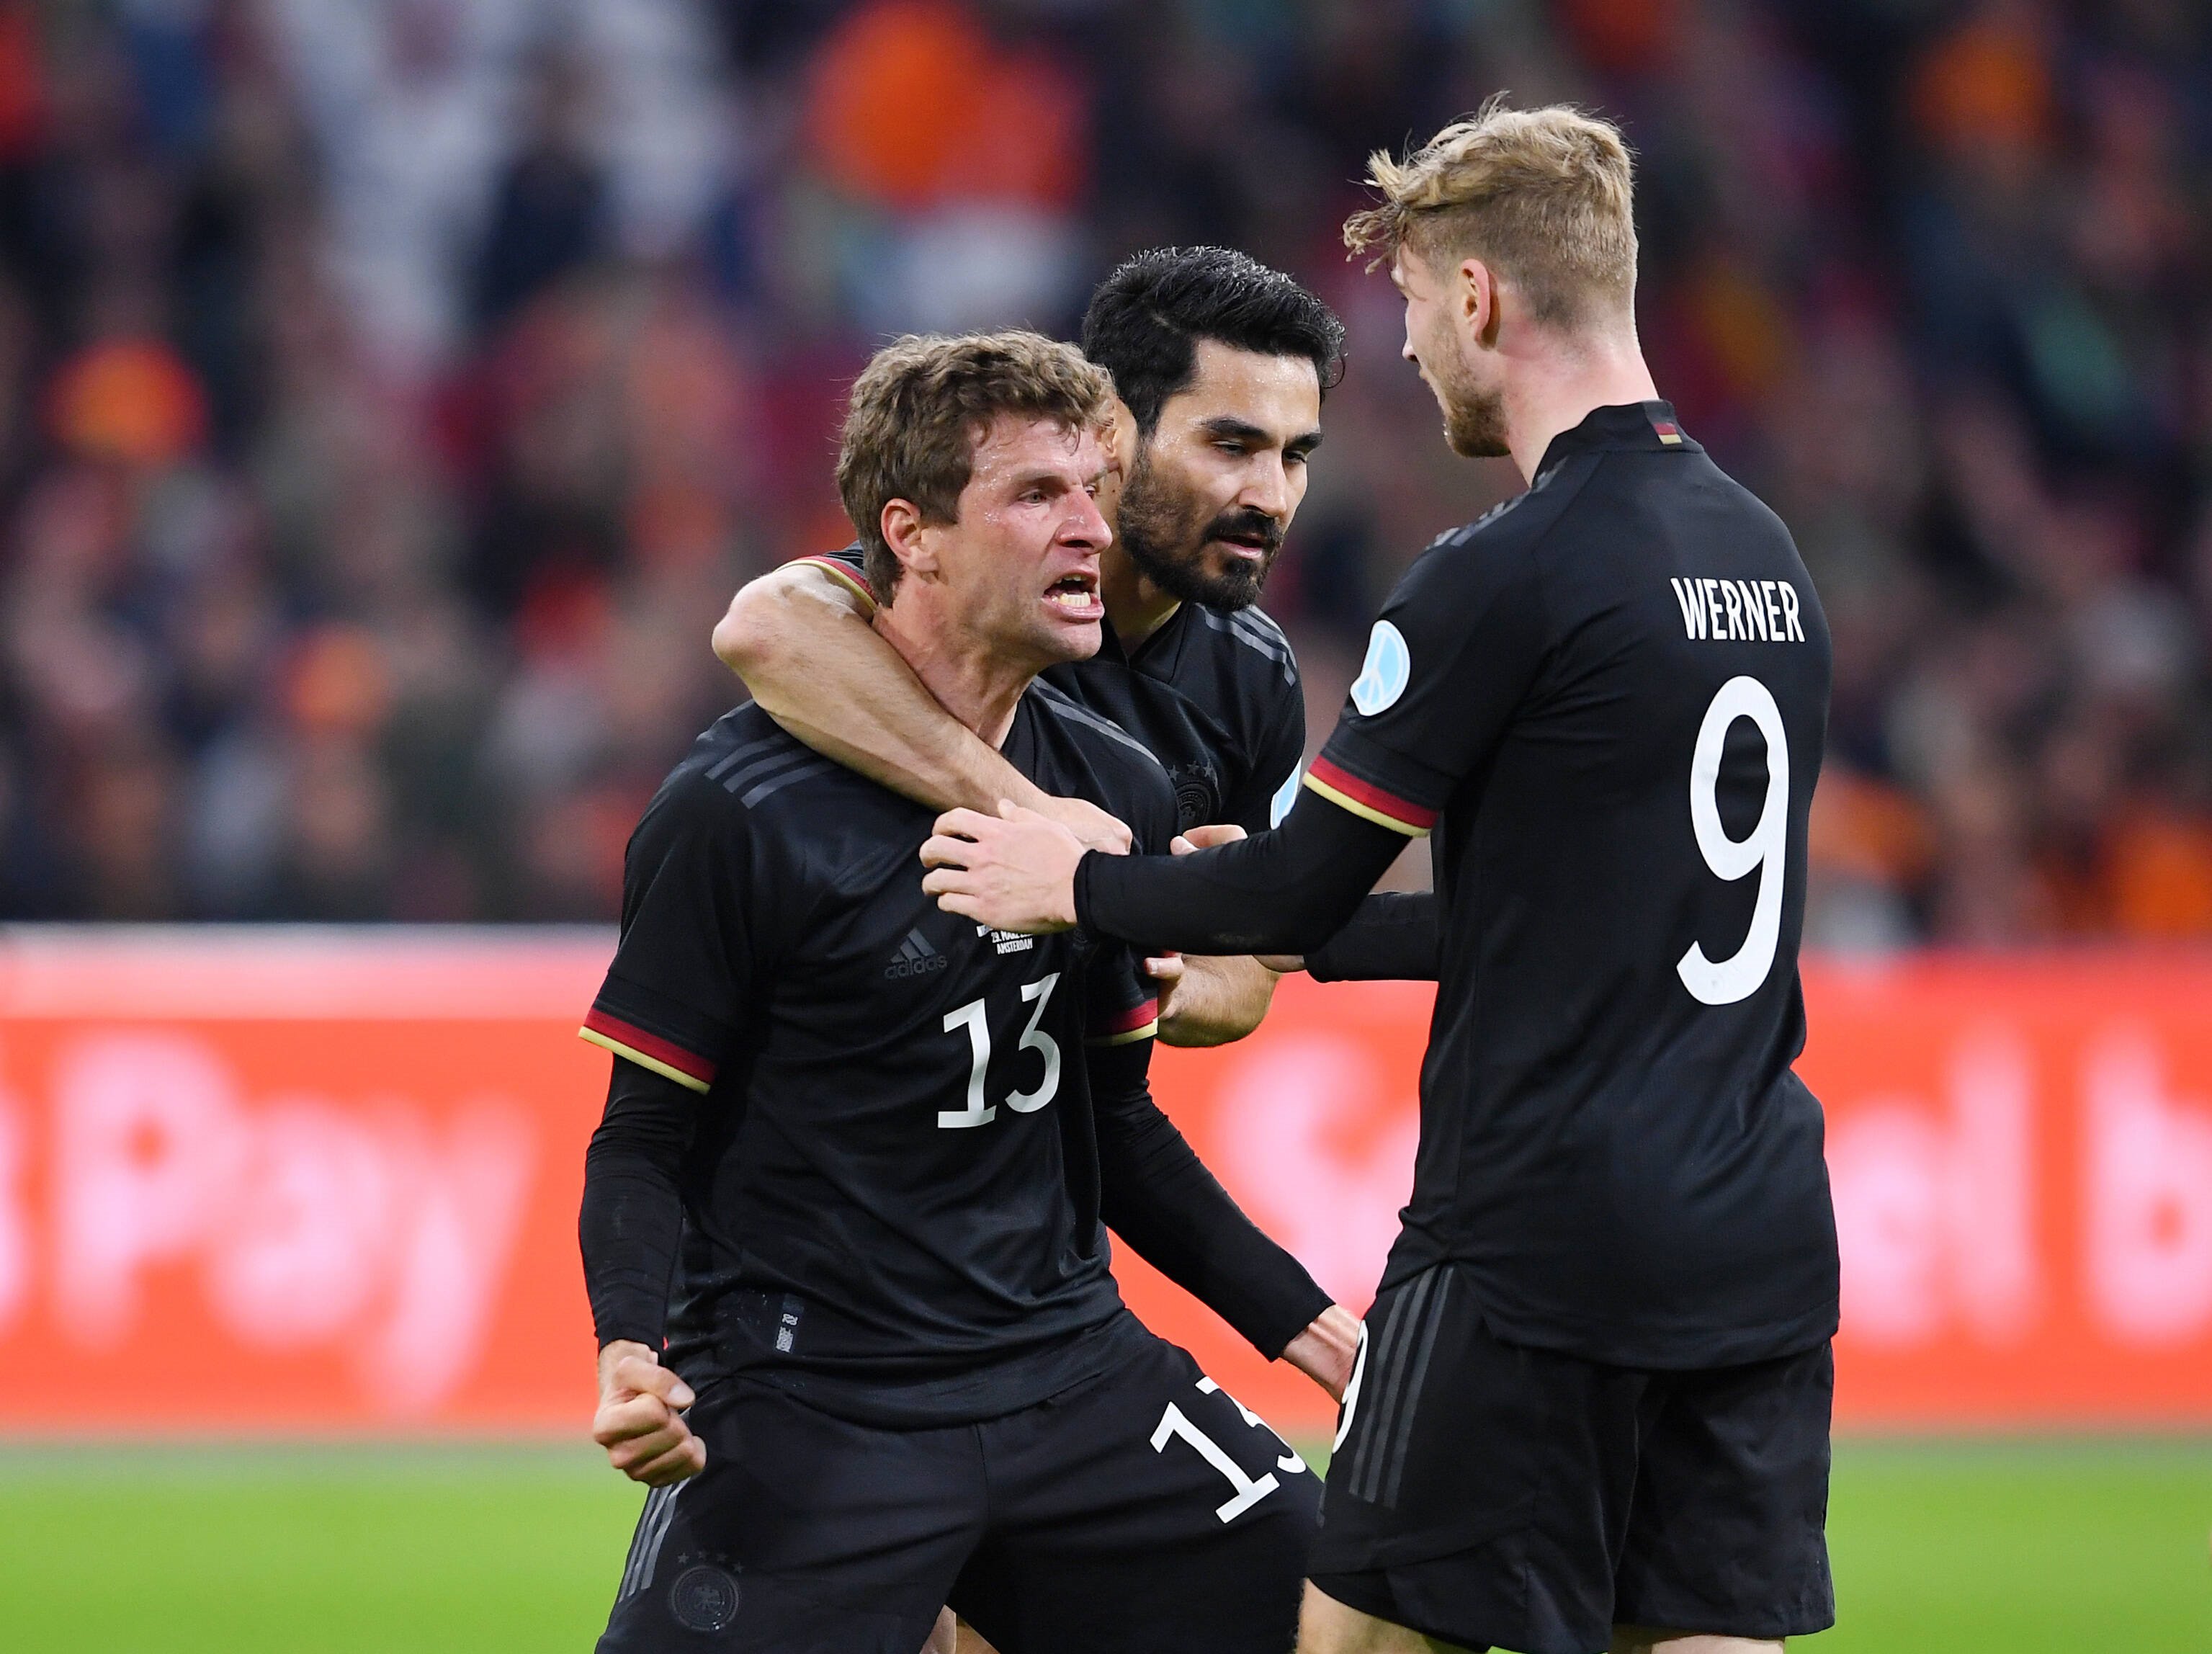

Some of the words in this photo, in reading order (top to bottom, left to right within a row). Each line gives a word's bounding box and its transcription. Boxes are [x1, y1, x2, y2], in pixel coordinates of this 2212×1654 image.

[1670, 577, 1806, 643] WERNER
[1675, 675, 1790, 1006] 9
[885, 955, 947, 979] adidas
[997, 938, 1033, 955] AMSTERDAM
[937, 972, 1062, 1129] 13
